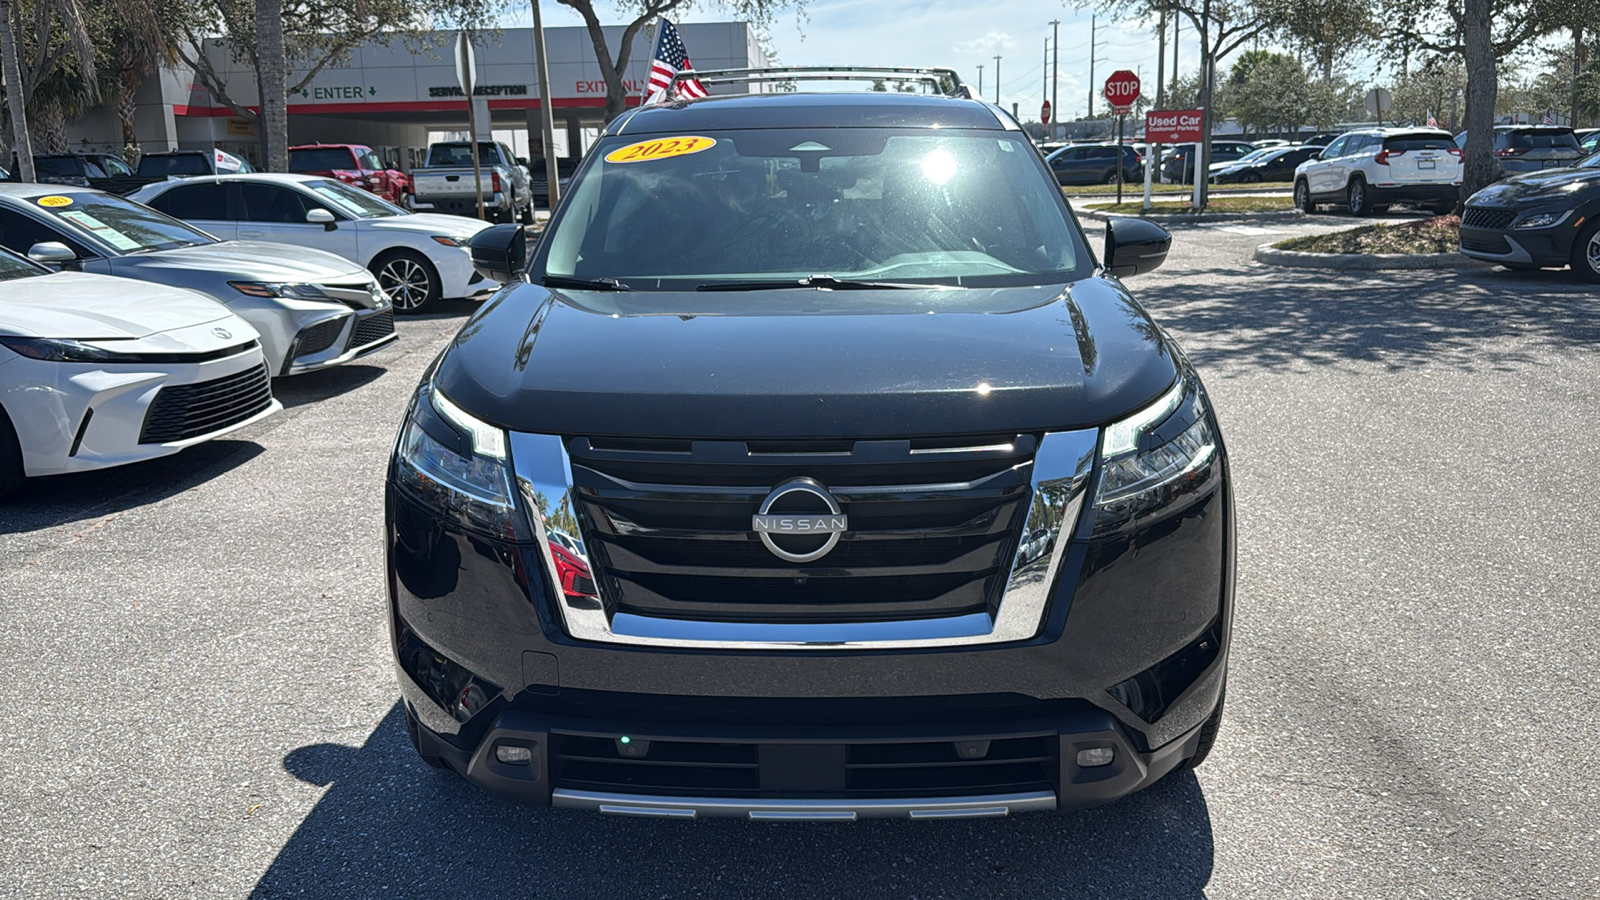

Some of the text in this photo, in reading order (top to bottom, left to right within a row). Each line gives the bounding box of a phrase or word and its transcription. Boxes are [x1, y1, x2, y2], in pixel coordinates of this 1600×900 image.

[314, 86, 363, 99] ENTER
[576, 81, 606, 93] EXIT
[1107, 81, 1138, 96] STOP
[1148, 115, 1200, 126] Used Car
[622, 139, 699, 160] 2023
[755, 517, 845, 530] NISSAN
